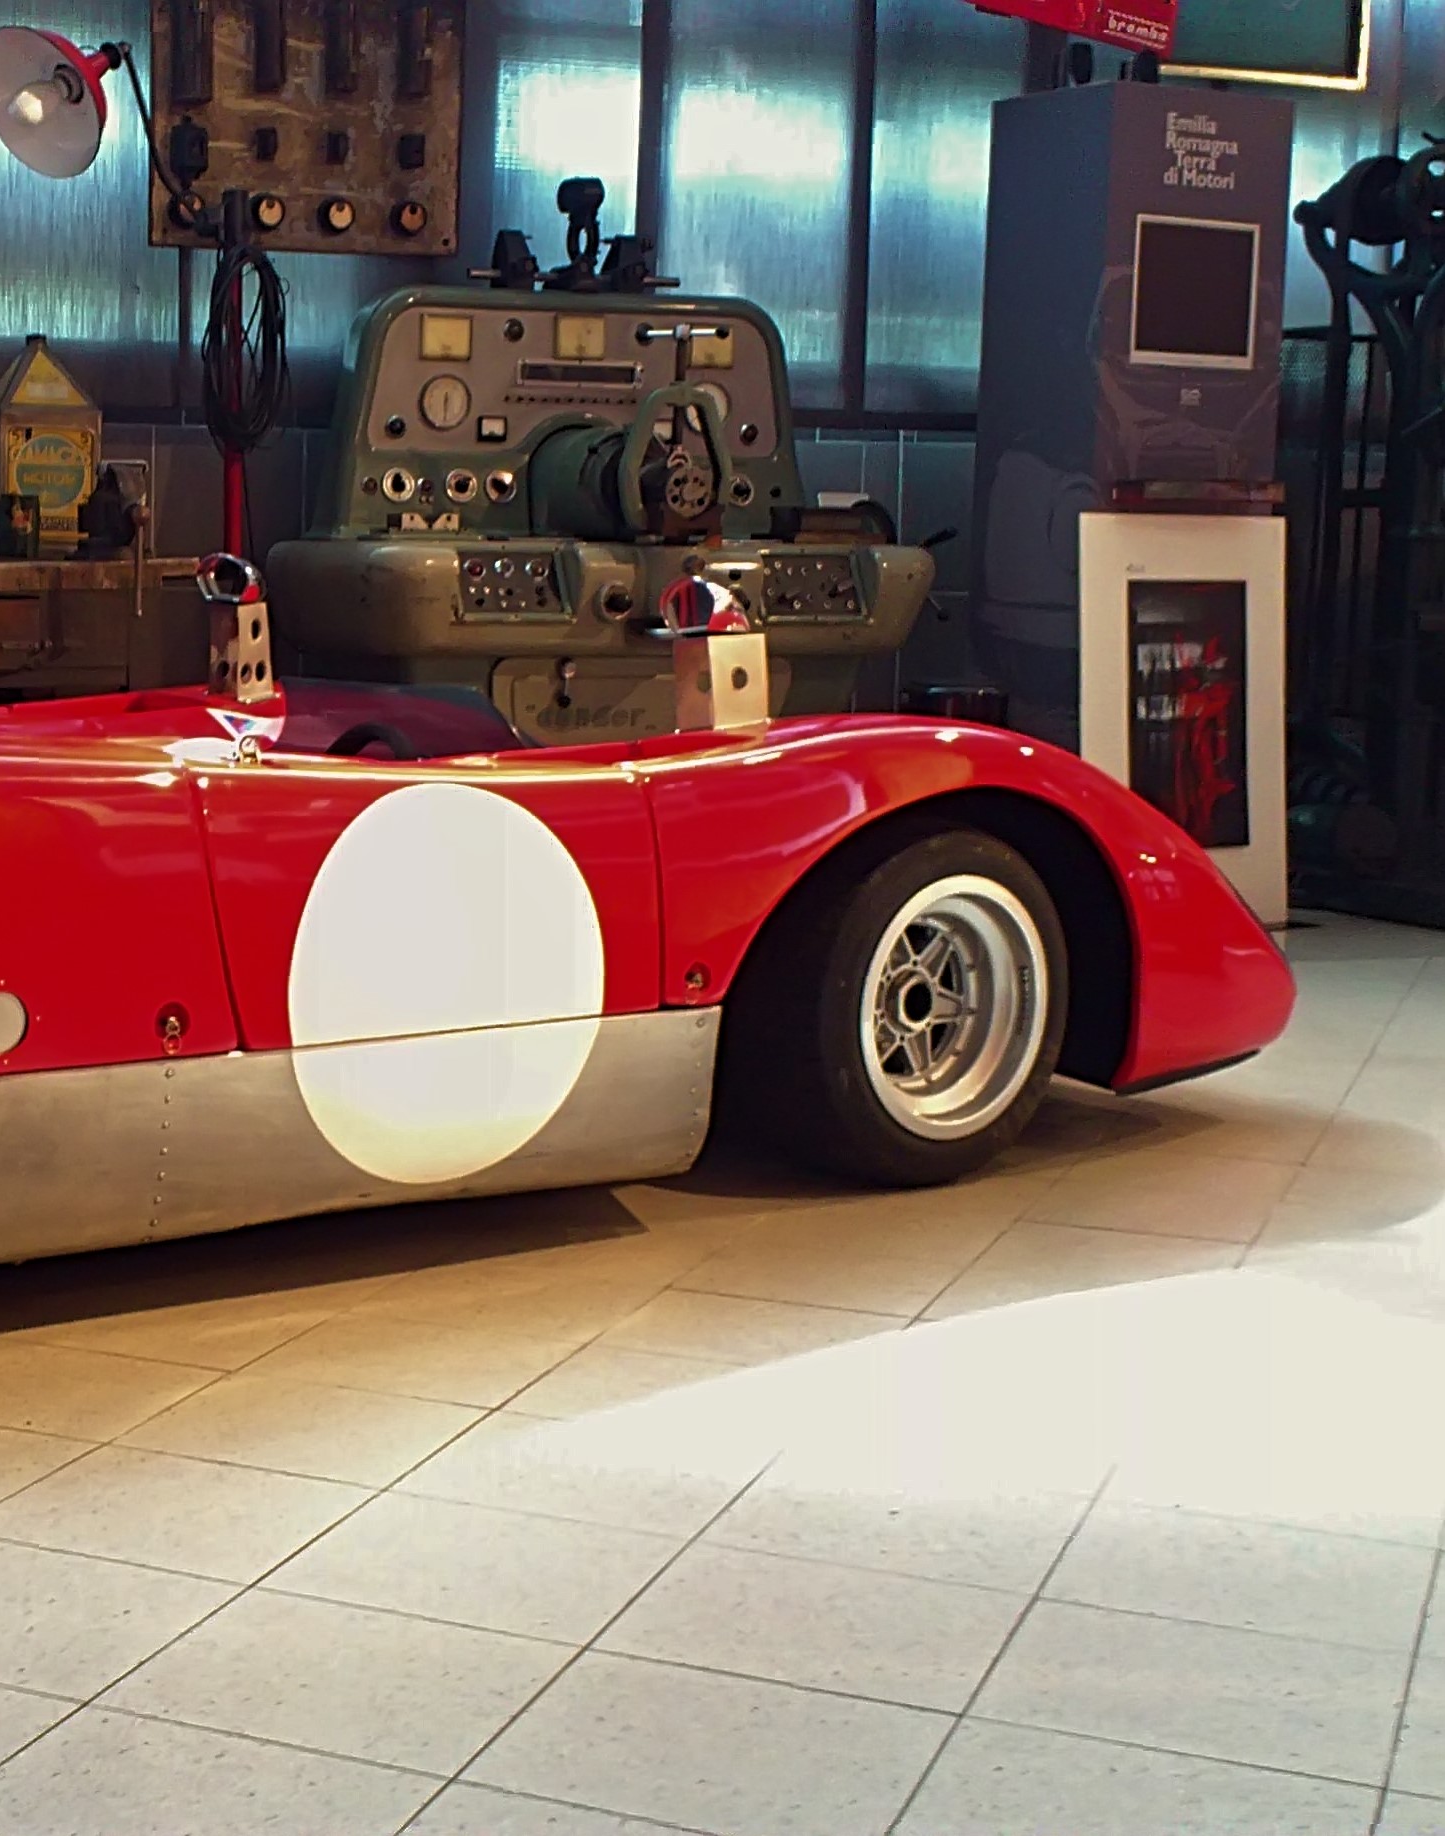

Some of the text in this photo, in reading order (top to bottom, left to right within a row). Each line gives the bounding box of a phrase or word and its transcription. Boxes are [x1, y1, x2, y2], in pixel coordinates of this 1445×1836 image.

[1166, 112, 1216, 135] Emilia
[1165, 130, 1238, 159] Romagna
[1174, 150, 1216, 171] Terra
[1163, 166, 1235, 190] di Motori
